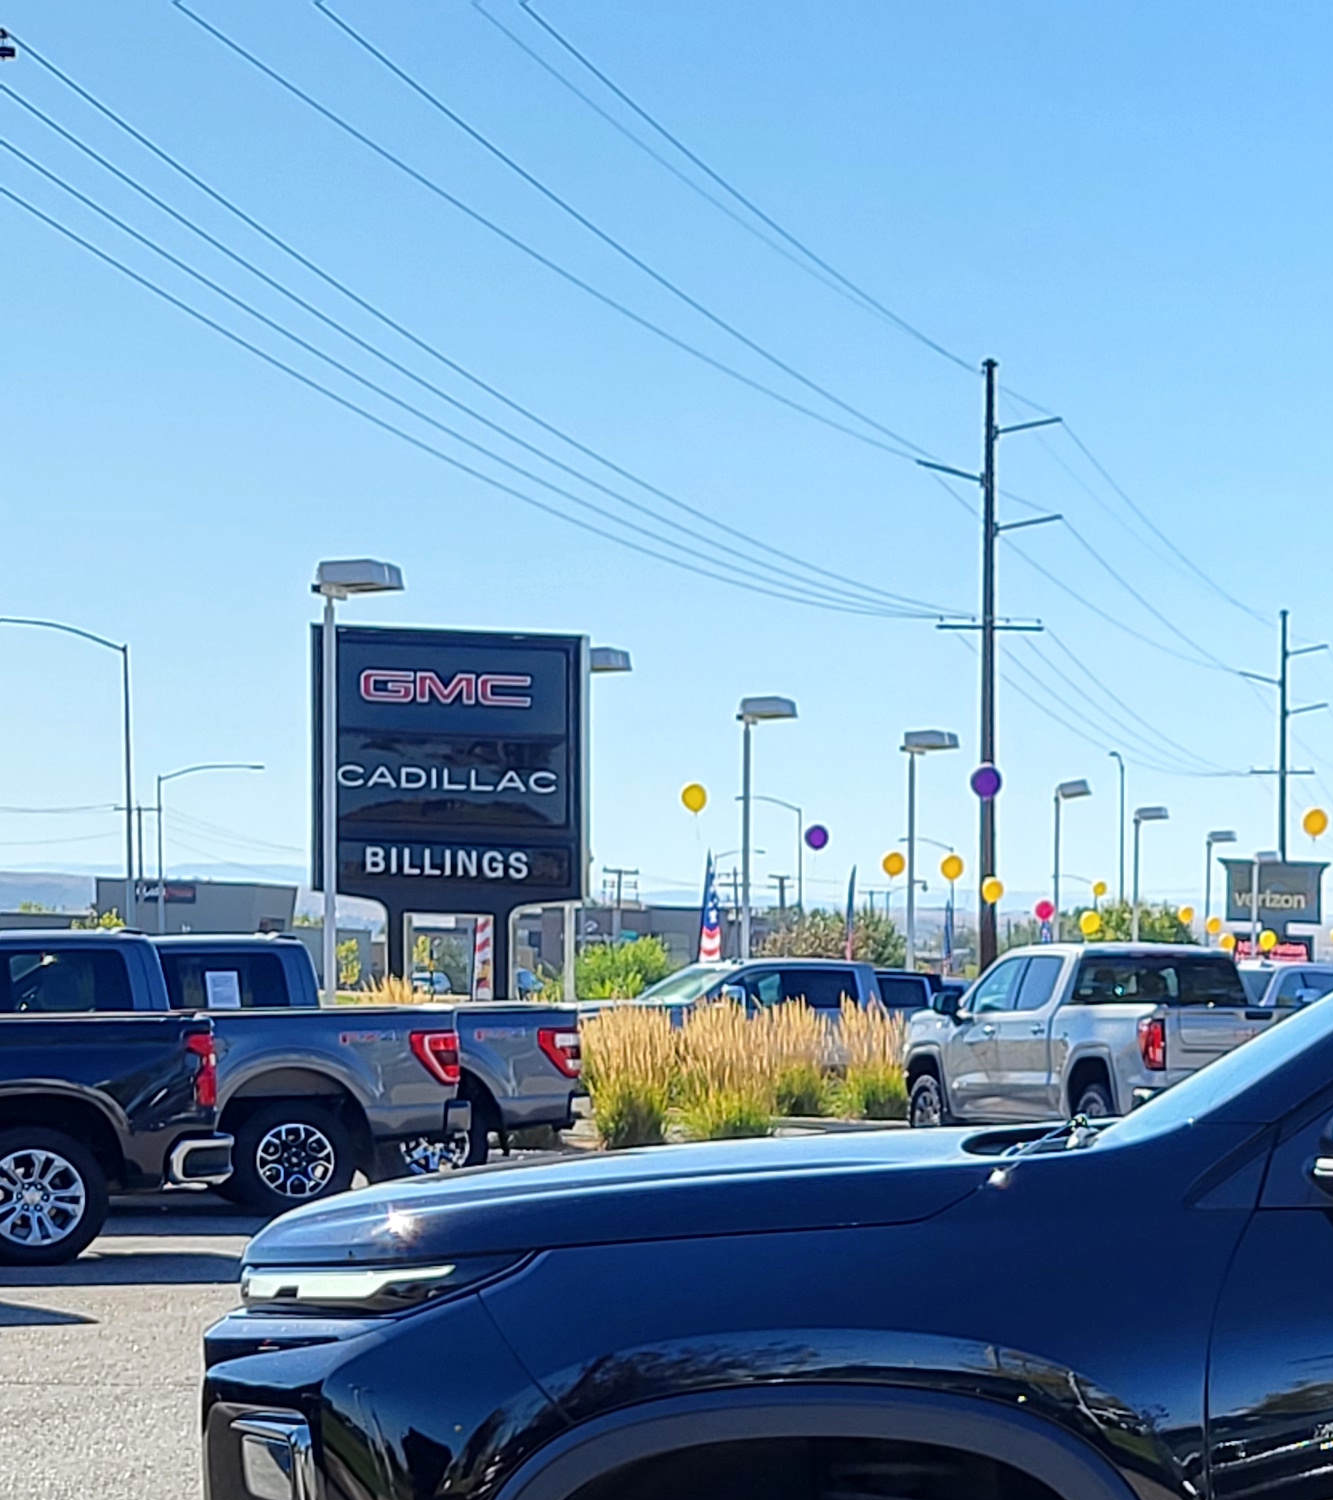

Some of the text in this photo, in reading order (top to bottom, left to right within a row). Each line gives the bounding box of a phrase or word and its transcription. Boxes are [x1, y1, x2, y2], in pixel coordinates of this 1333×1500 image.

[360, 669, 531, 707] GMC
[337, 764, 558, 793] CADILLAC
[364, 845, 529, 880] BILLINGS
[1234, 889, 1306, 909] verizon
